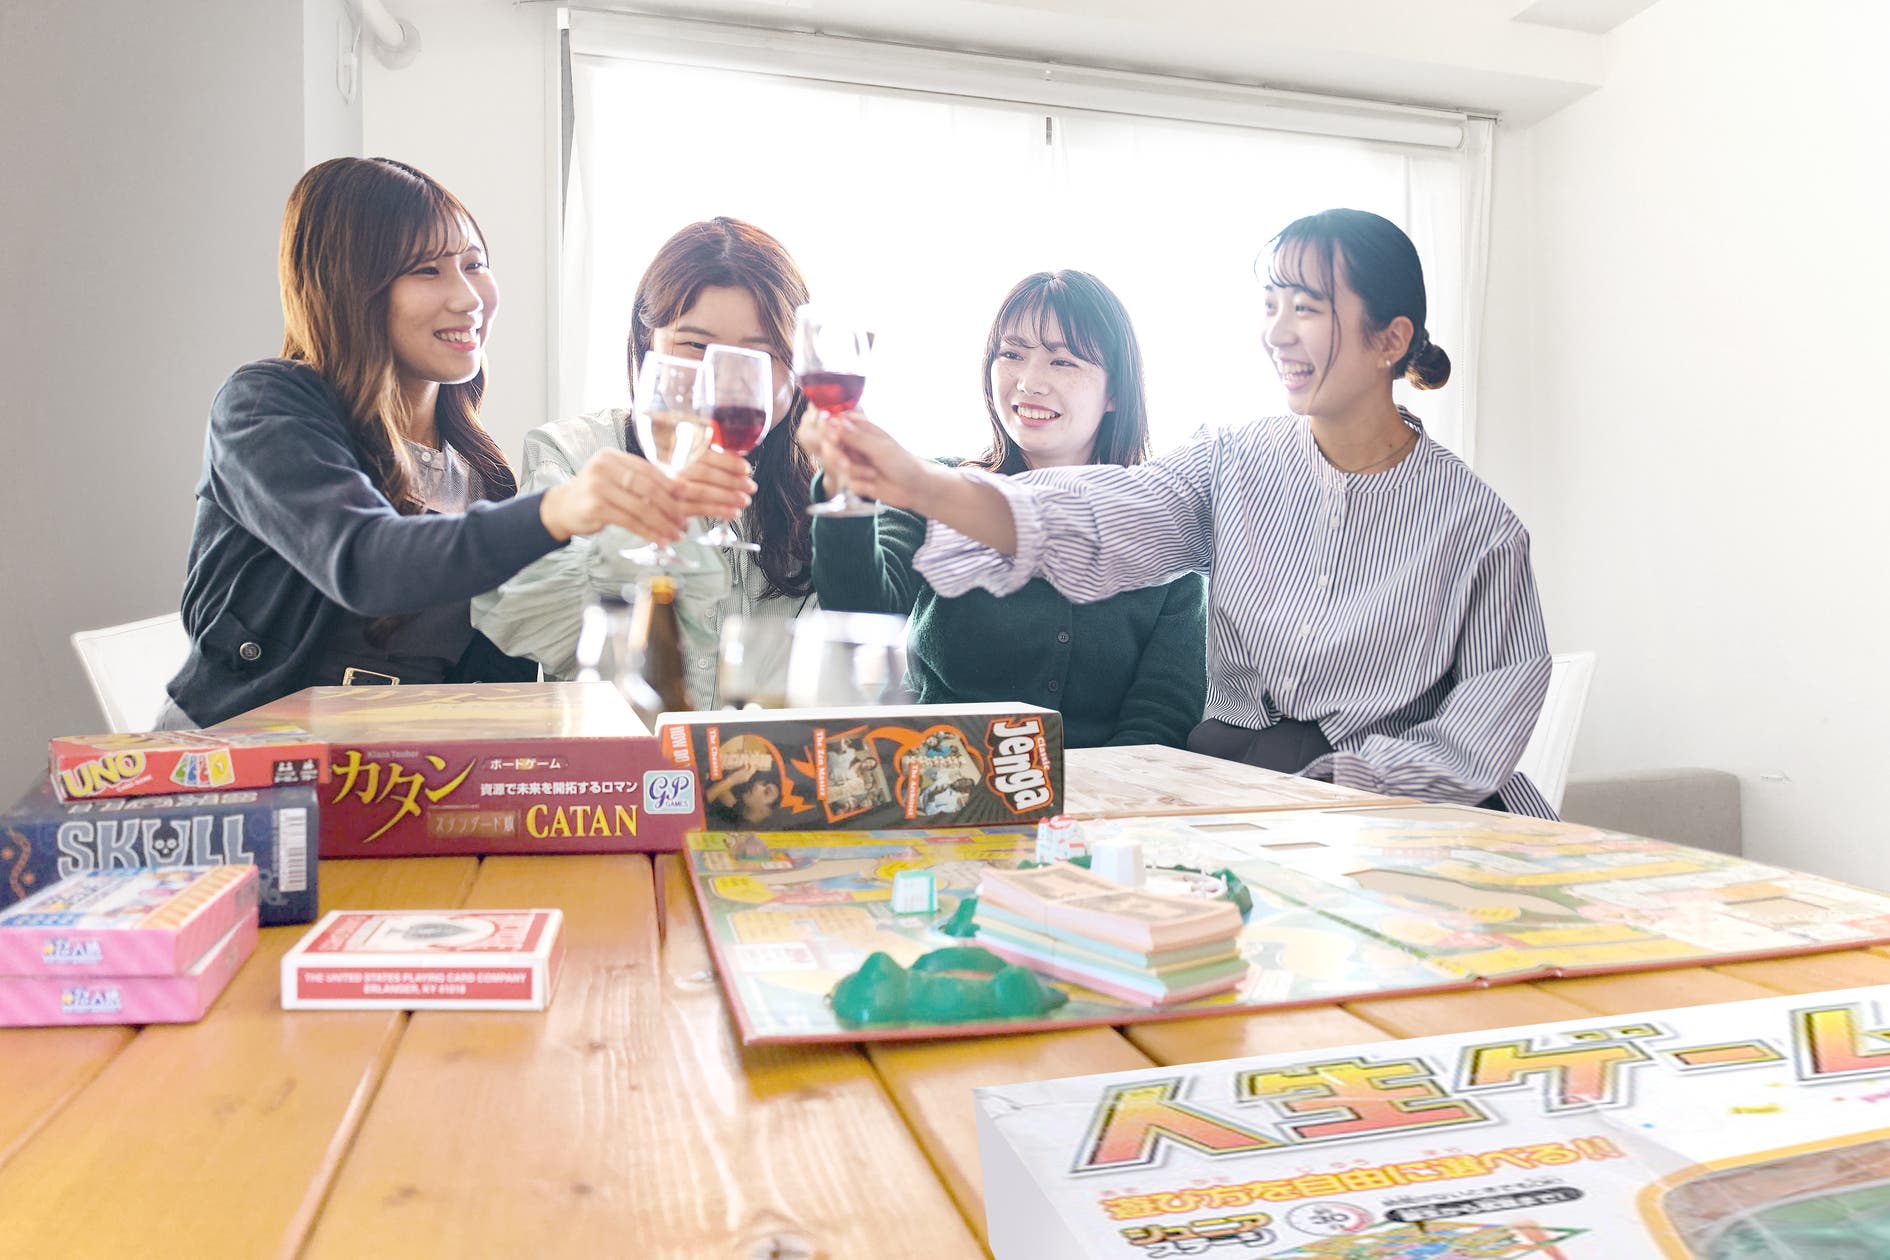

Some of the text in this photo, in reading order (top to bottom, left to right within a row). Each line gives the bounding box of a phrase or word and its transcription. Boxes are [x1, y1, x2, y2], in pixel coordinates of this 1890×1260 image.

[490, 757, 561, 770] ボードゲーム
[816, 731, 826, 796] The Zen Master
[992, 720, 1050, 810] Jenga
[1037, 737, 1051, 770] Classic
[60, 751, 146, 798] UNO
[480, 781, 638, 797] 資源で未来を開拓するロマン
[649, 776, 690, 808] GP
[907, 764, 919, 816] The Architect
[332, 750, 477, 843] カタン
[666, 800, 688, 808] GAMES
[526, 804, 638, 838] CATAN
[57, 814, 254, 880] SKULL
